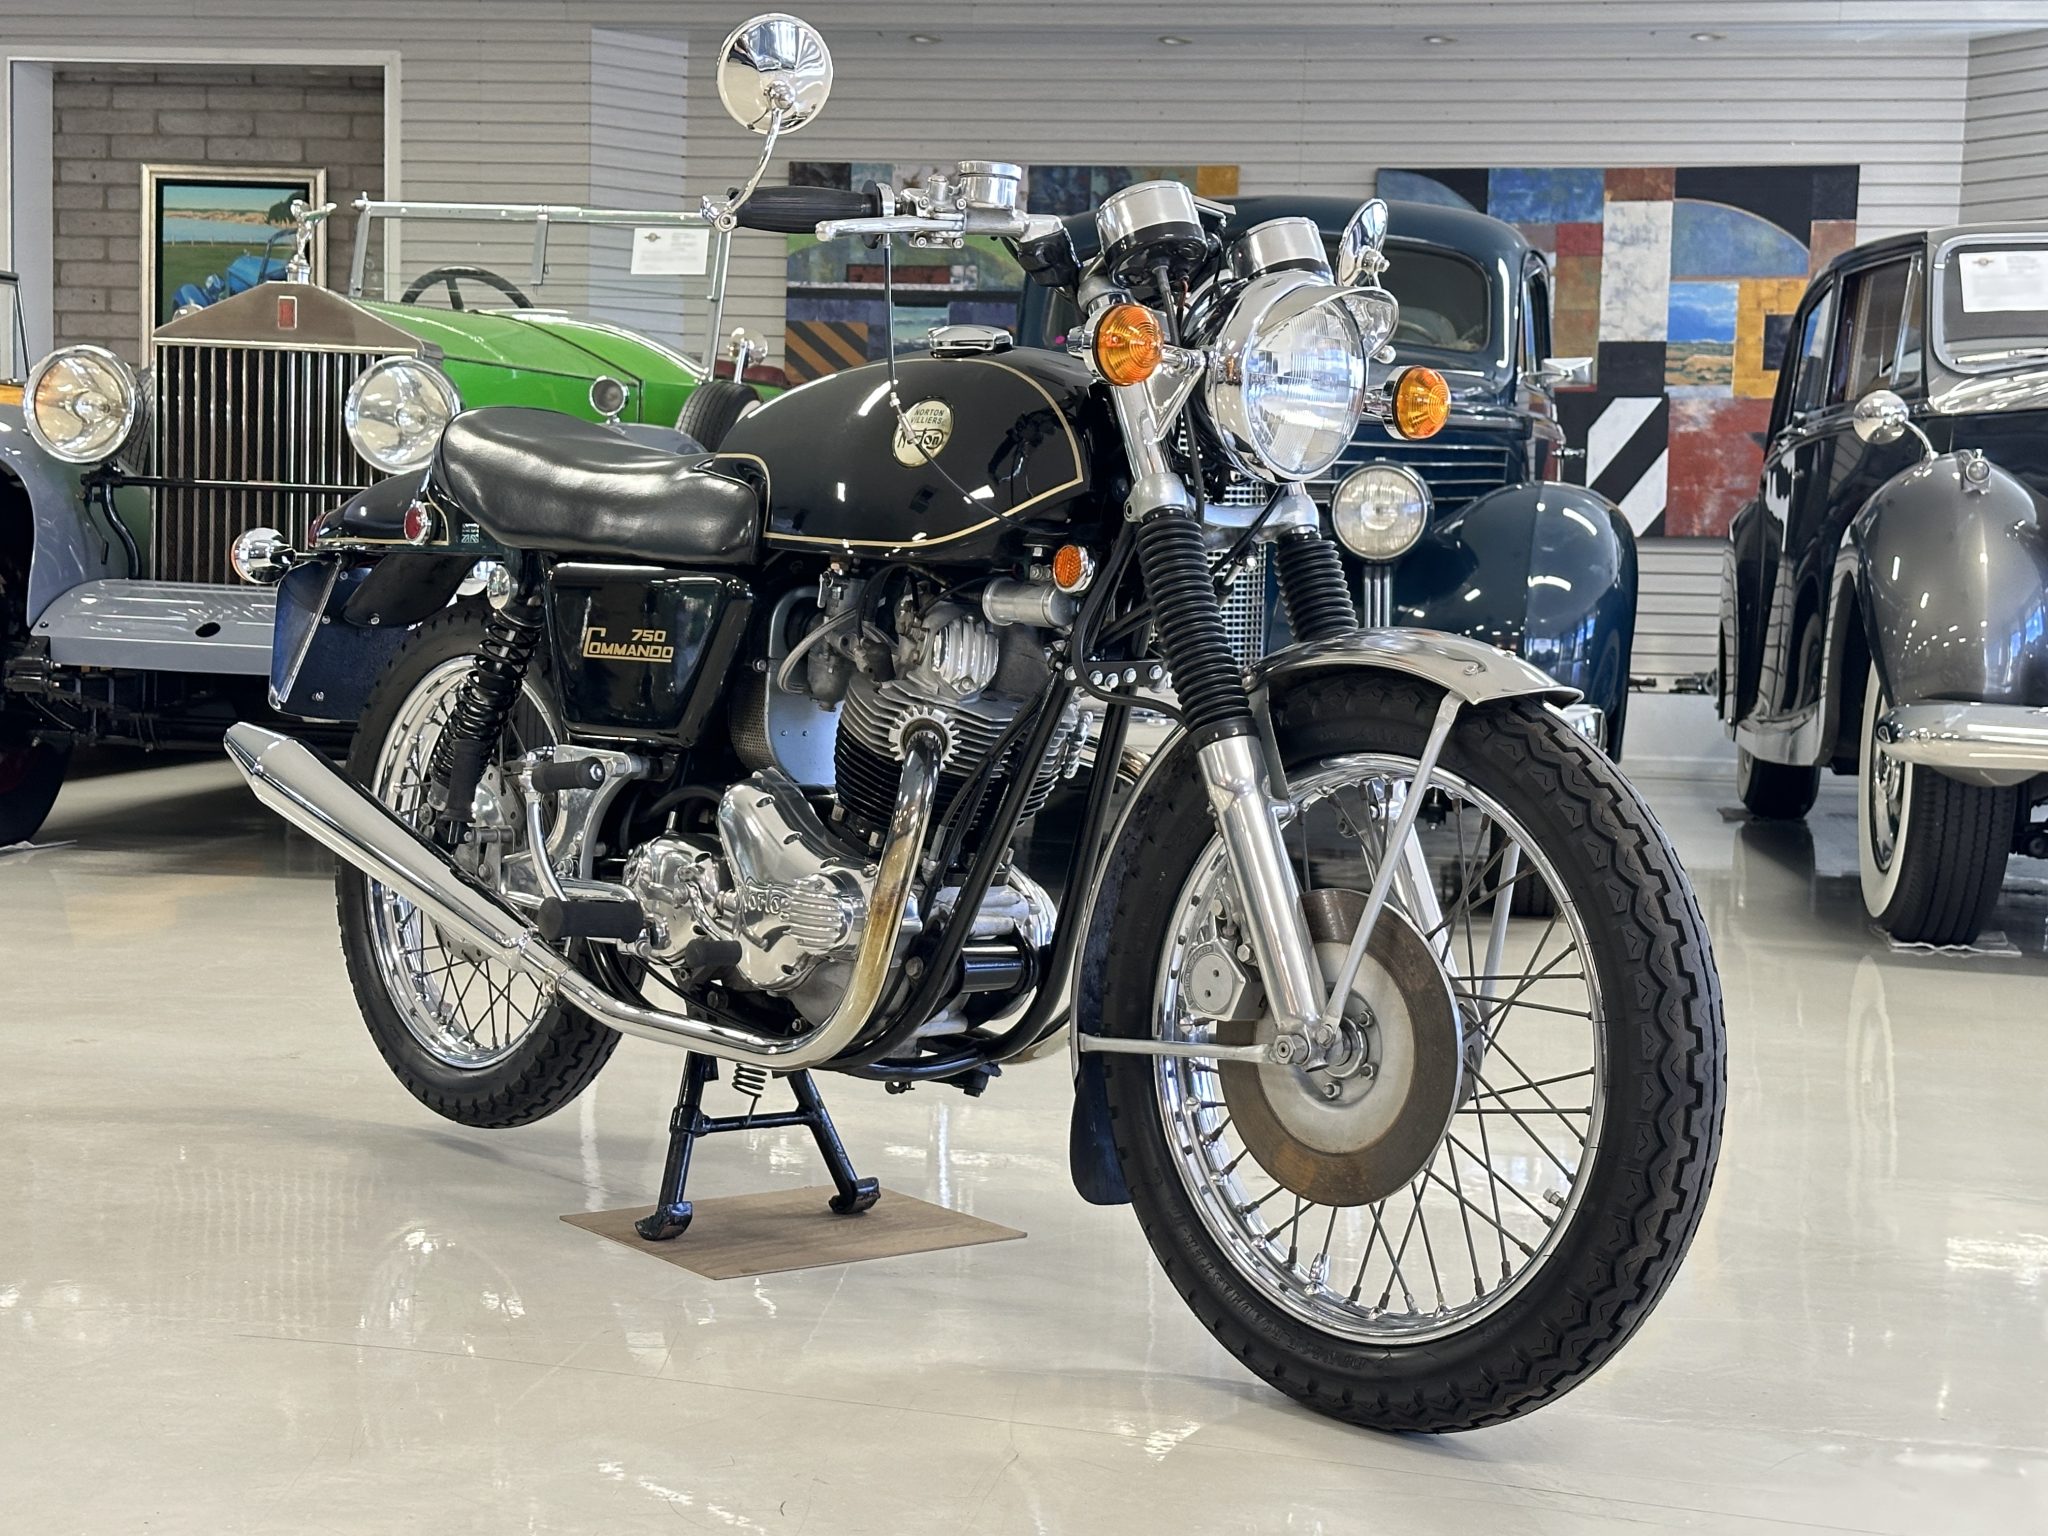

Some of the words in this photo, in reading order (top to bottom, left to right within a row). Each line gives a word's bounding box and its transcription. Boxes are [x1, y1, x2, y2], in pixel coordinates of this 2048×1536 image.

[914, 408, 945, 417] NORTON
[910, 416, 943, 425] VILLIERS
[897, 427, 944, 450] Nton
[632, 628, 666, 642] 750
[583, 627, 674, 663] COMMANDO
